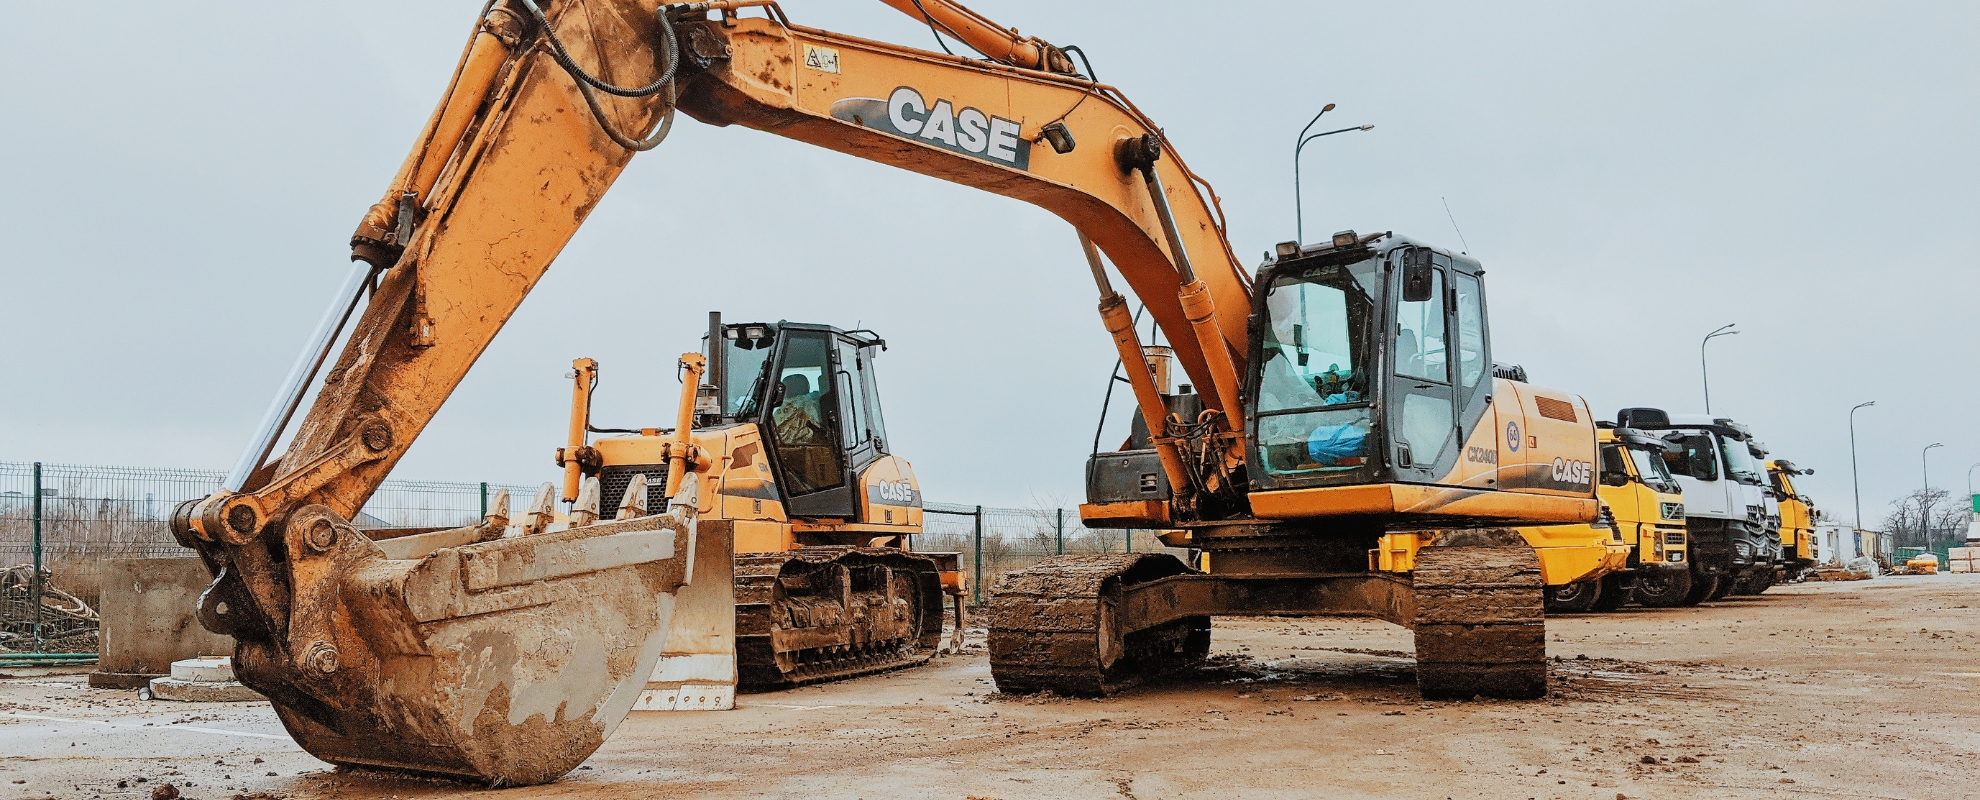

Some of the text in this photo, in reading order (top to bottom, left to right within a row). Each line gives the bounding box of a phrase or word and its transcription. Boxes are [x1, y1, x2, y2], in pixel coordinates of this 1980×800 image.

[888, 86, 1021, 163] CASE
[1303, 265, 1339, 277] CASE
[1552, 457, 1591, 485] CASE
[879, 480, 912, 502] CASE
